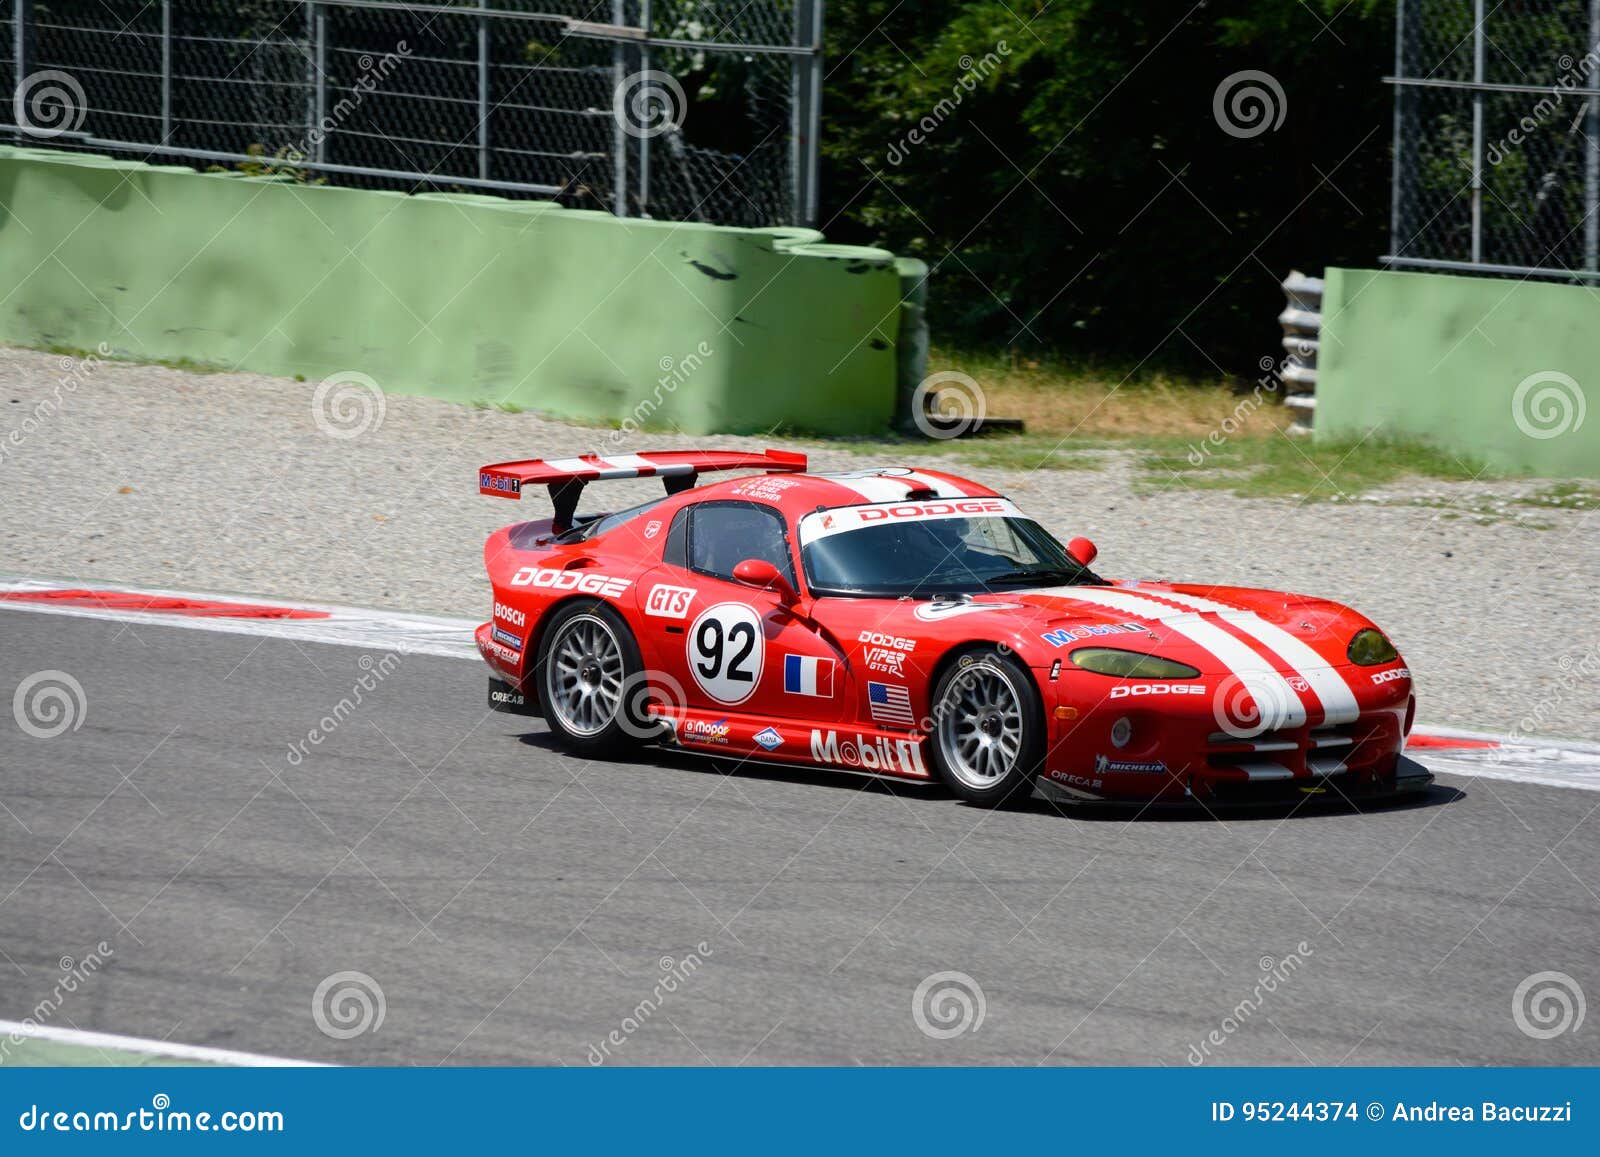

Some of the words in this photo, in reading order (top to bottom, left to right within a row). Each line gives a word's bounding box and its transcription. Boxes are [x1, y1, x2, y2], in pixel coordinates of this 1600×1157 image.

[857, 502, 1005, 522] DODGE
[511, 566, 633, 598] DODGE
[650, 587, 691, 613] GTS
[495, 601, 526, 628] BOSCH
[696, 618, 754, 682] 92
[858, 630, 917, 652] DODGE
[863, 645, 907, 672] VIPER
[491, 691, 517, 704] ORECA
[1110, 684, 1206, 699] DODGE
[695, 720, 729, 736] Mopar
[810, 729, 896, 772] Mobil
[1051, 769, 1091, 787] ORECA
[1109, 763, 1165, 772] MICHELIN
